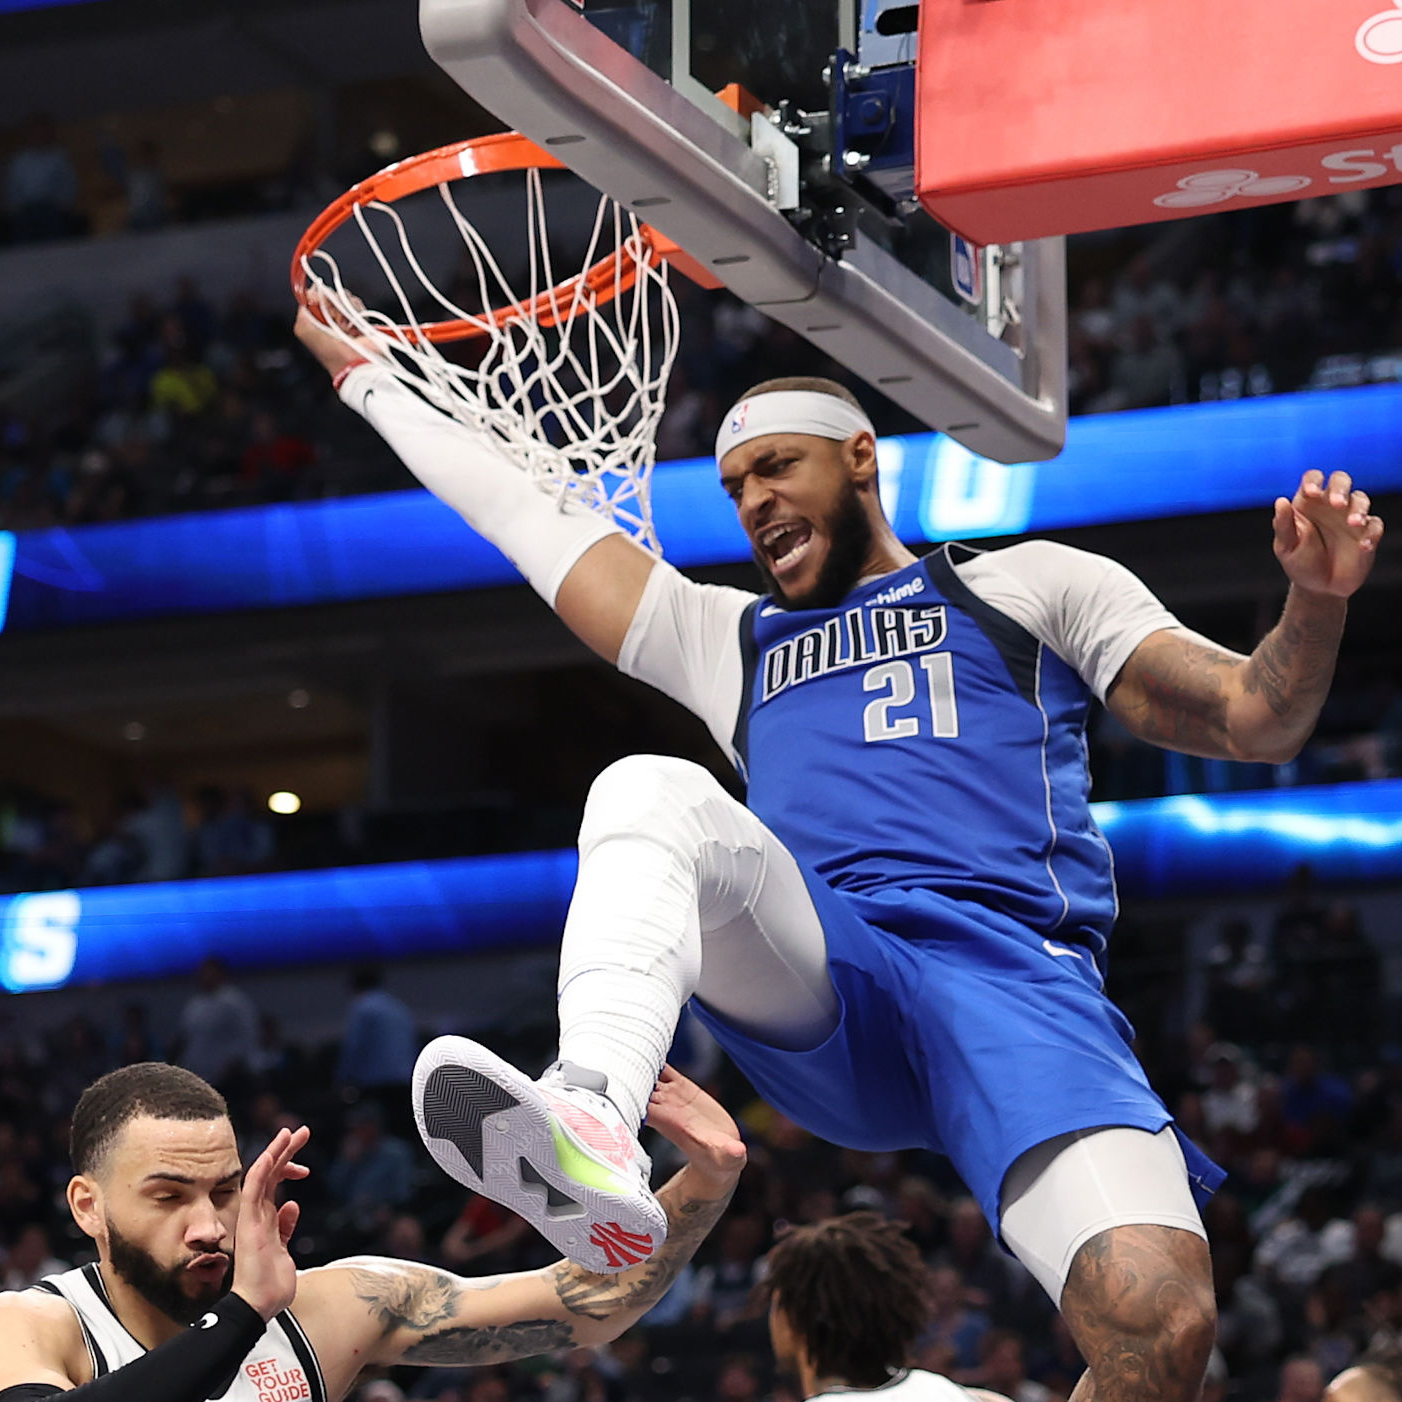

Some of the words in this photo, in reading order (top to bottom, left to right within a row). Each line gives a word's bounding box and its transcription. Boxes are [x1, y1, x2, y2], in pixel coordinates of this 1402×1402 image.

[762, 605, 948, 702] DALLAS
[863, 651, 959, 742] 21
[245, 1358, 278, 1378] GET
[251, 1368, 303, 1393] YOUR
